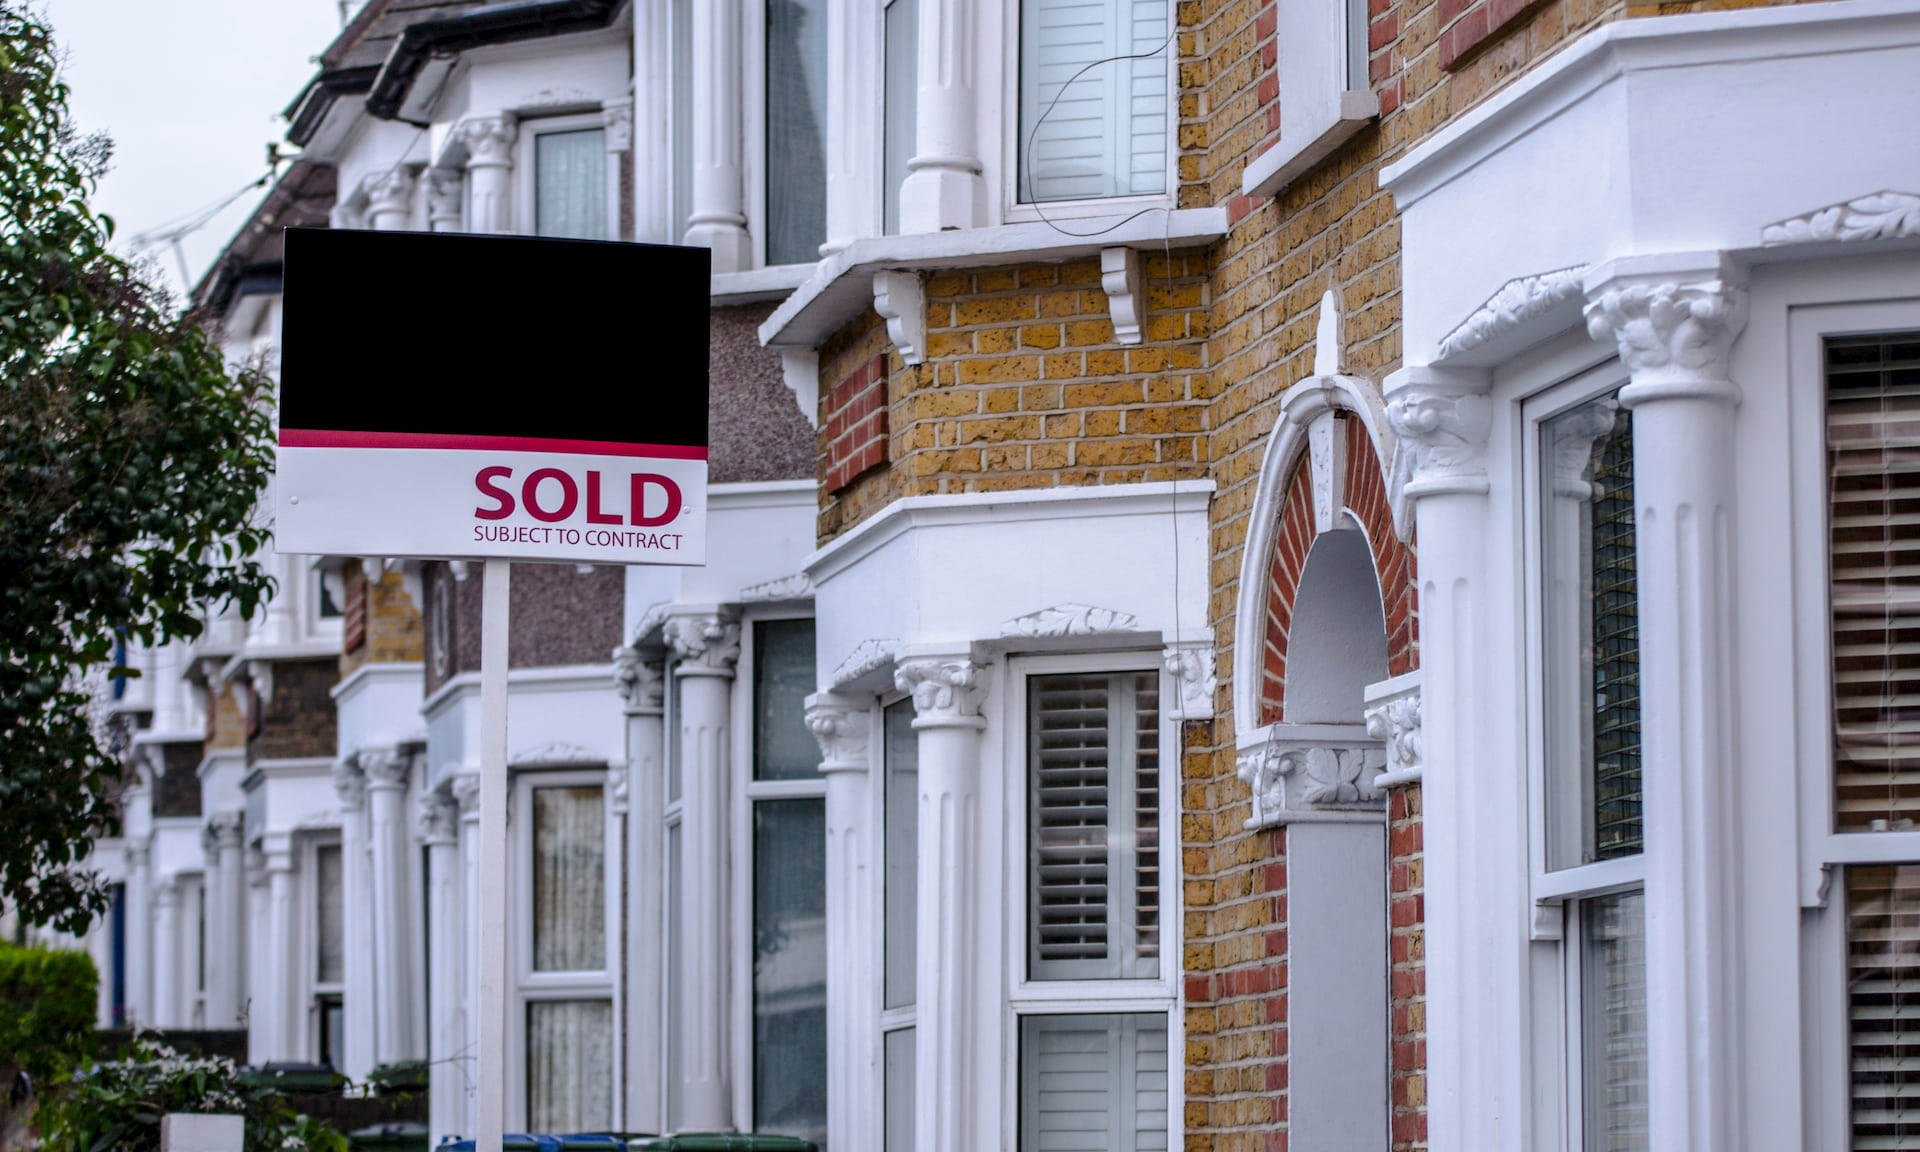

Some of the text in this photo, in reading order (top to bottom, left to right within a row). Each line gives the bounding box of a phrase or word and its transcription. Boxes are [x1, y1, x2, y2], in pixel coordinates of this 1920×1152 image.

[474, 465, 683, 528] SOLD
[473, 525, 683, 550] SUBJECT TO CONTRACT
